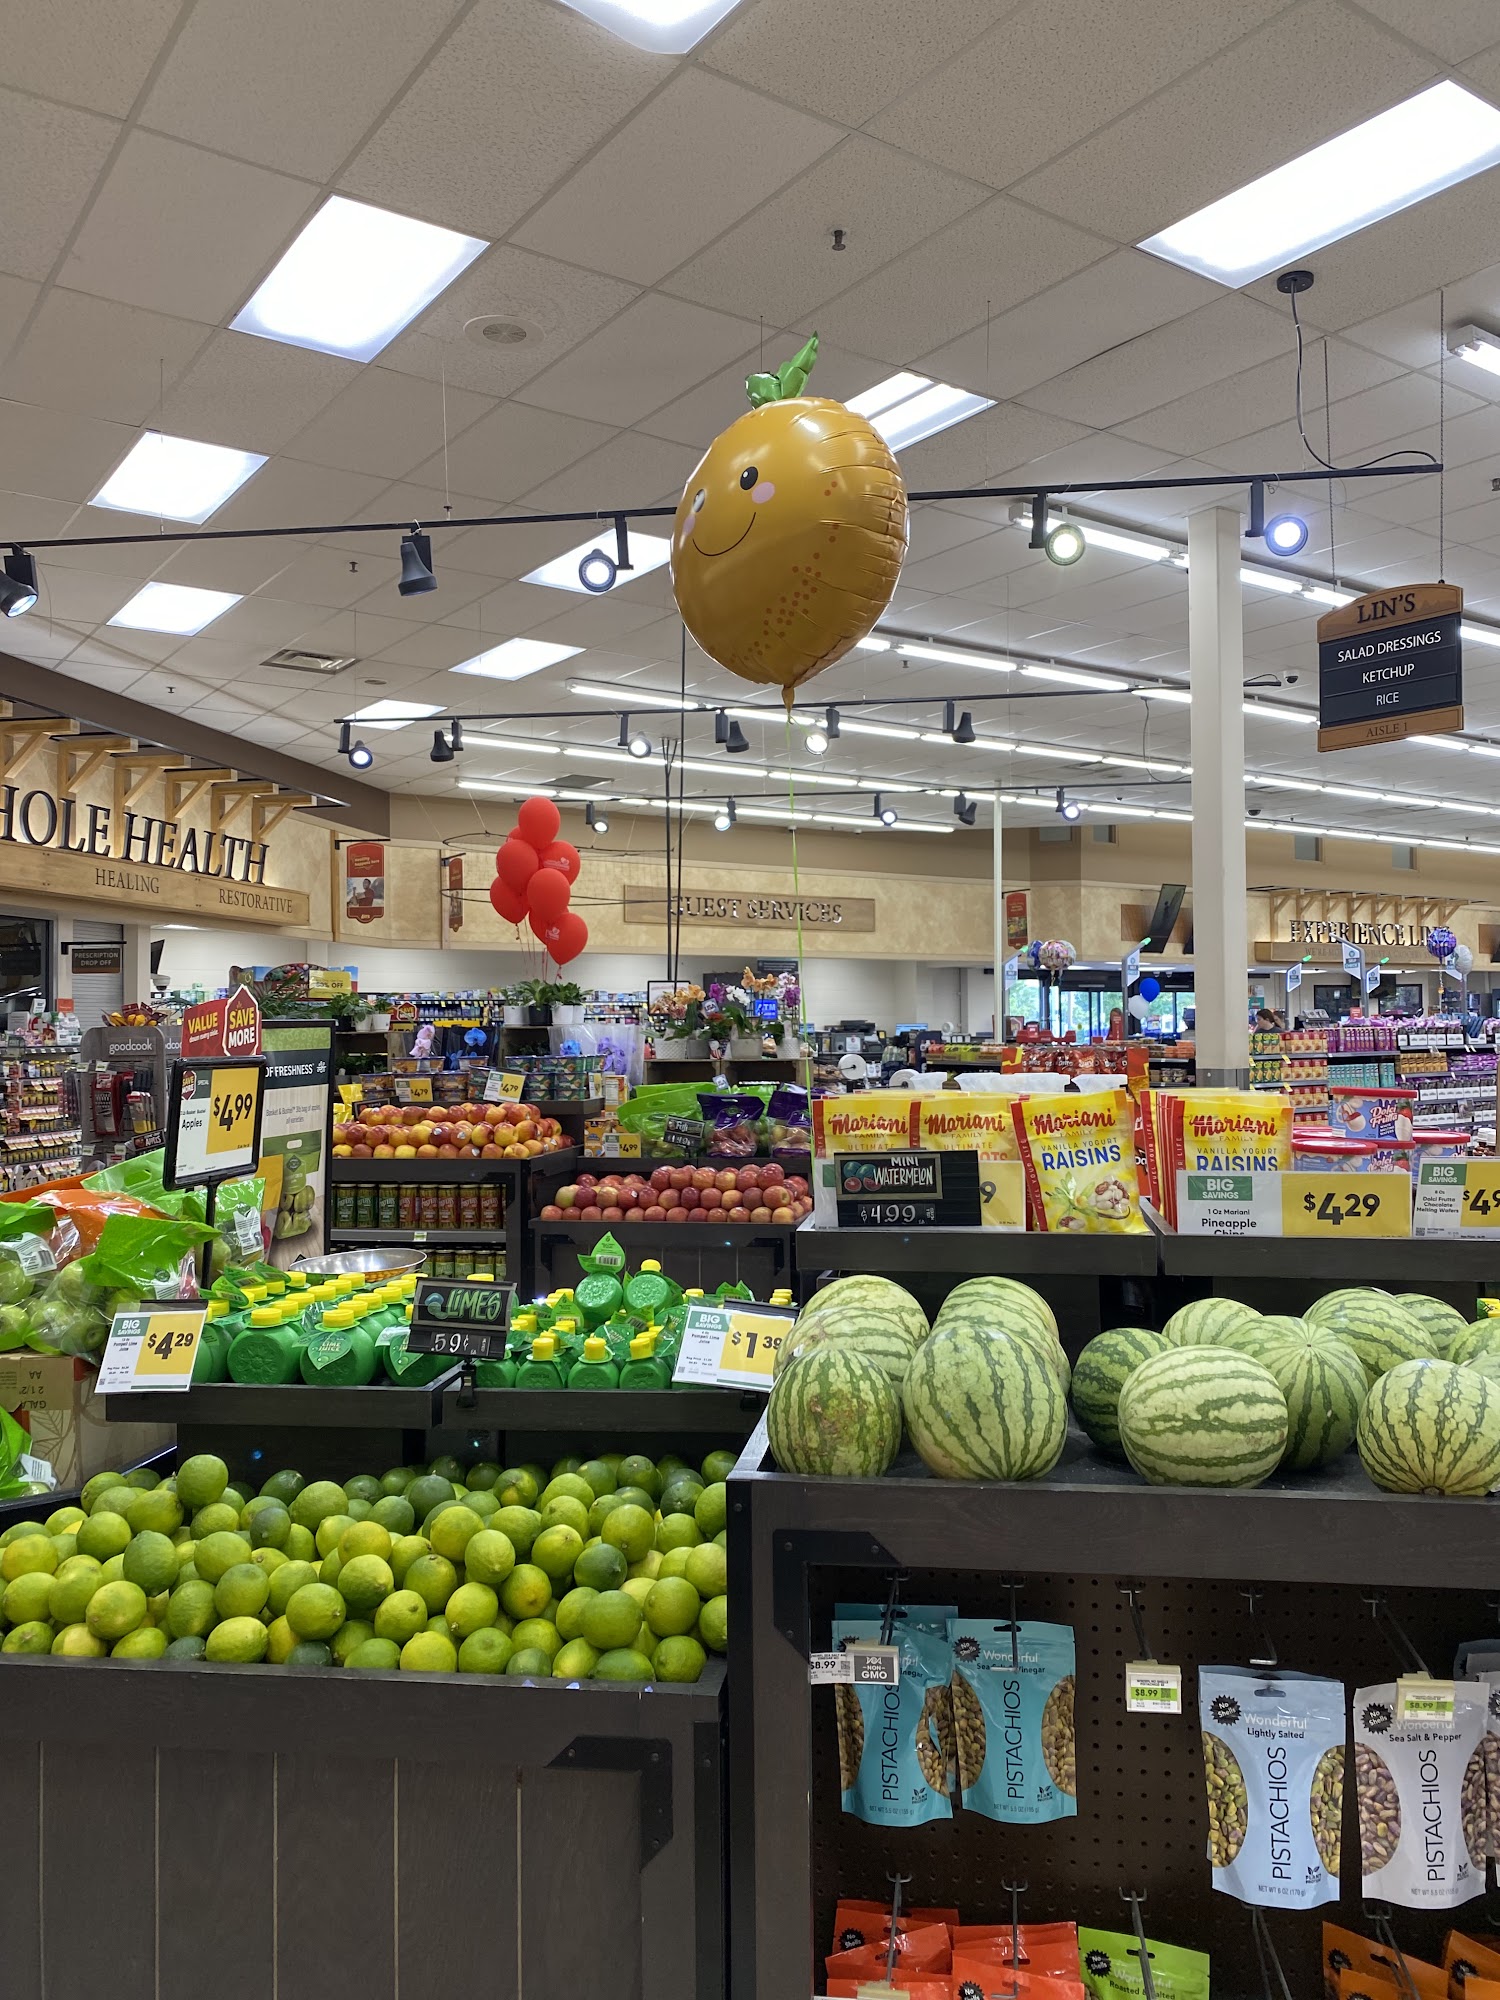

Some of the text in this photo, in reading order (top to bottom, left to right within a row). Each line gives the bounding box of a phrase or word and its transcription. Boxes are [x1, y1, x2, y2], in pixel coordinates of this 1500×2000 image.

[1357, 593, 1415, 623] LIN'S
[1338, 631, 1442, 662] SALAD DRESSINGS
[1362, 663, 1415, 683] KETCHUP
[1376, 692, 1399, 706] RICE
[1367, 722, 1409, 738] AISLE 1
[121, 811, 270, 885] HEALTH
[95, 868, 293, 914] HEALING RESTORATIVE
[670, 896, 842, 924] GUEST SERVICES
[1289, 920, 1406, 946] EXPERIENCE
[188, 1012, 218, 1034] VALUE
[229, 1007, 255, 1030] SAVE
[228, 1027, 255, 1049] MORE
[109, 1038, 153, 1055] goodcook
[275, 1063, 313, 1077] FRESHNESS
[1370, 1105, 1397, 1117] Dolci
[181, 1118, 202, 1131] Apples
[828, 1113, 909, 1136] Mariani
[924, 1112, 1006, 1136] Mariani
[1030, 1108, 1116, 1136] Mariani
[1189, 1114, 1278, 1137] Mariani
[1370, 1113, 1398, 1128] Frutta
[1060, 1129, 1093, 1137] FAMILY
[943, 1141, 993, 1150] ULTIMATE
[1041, 1137, 1118, 1152] VANILLA YOGURT
[891, 1156, 919, 1167] MINI
[1041, 1144, 1121, 1171] RAISINS
[1197, 1155, 1278, 1171] RAISINS
[873, 1165, 933, 1186] WATERMELON
[1432, 1166, 1455, 1177] BIG
[1207, 1179, 1235, 1191] BIG
[1202, 1191, 1239, 1199] SAVINGS
[1223, 1208, 1250, 1216] Mariani
[1201, 1218, 1257, 1230] Pineapple
[121, 1319, 140, 1330] BIG
[699, 1313, 720, 1323] BIG
[117, 1328, 141, 1336] SAVINGS
[695, 1321, 722, 1330] SAVINGS
[29, 1370, 42, 1379] AA
[983, 1650, 1038, 1663] Wonrful
[861, 1671, 888, 1679] GMO
[900, 1668, 924, 1678] inegar
[1135, 1688, 1158, 1697] $8.99
[1409, 1701, 1434, 1709] $8.99
[1218, 1708, 1236, 1718] Shells
[1243, 1713, 1307, 1729] Wonderful
[1368, 1716, 1388, 1726] Shells
[1003, 1679, 1025, 1799] PISTACHIOS
[1247, 1727, 1305, 1739] Lightly Salted
[1389, 1734, 1405, 1742] Sea
[1406, 1733, 1422, 1742] Salt
[1432, 1733, 1462, 1742] Pepper
[1267, 1746, 1292, 1880] PISTACHIOS
[1418, 1749, 1446, 1881] PISTACHIOS
[1109, 1980, 1176, 2000] Roasted alted
